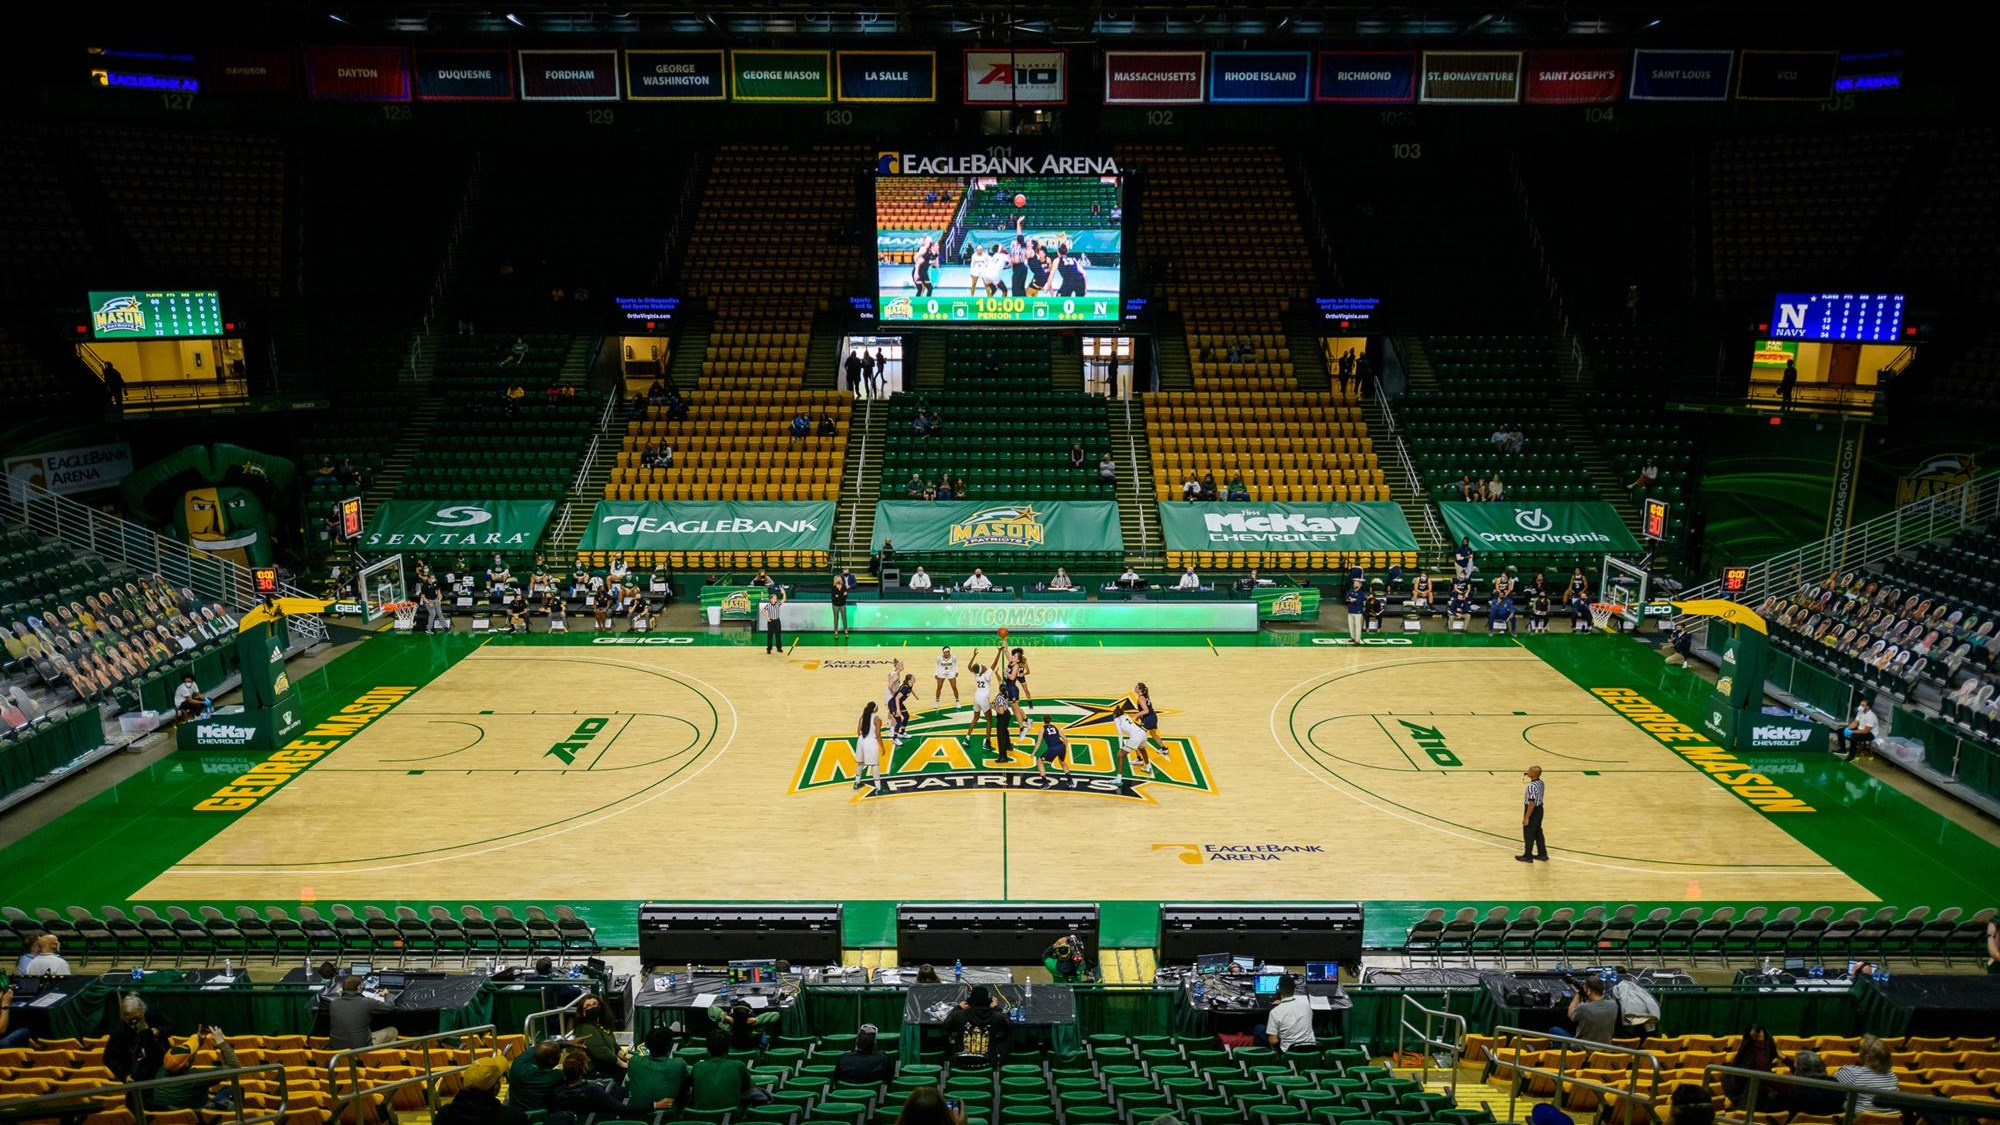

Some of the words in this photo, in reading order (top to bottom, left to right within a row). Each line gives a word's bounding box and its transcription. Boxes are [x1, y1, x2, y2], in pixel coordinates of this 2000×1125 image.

[337, 68, 379, 79] DAYTON
[438, 69, 492, 81] DUQUESNE
[545, 69, 595, 80] FORDHAM
[655, 64, 696, 74] GEORGE
[743, 70, 783, 81] GEORGE
[784, 70, 821, 81] MASON
[1651, 69, 1679, 80] SAINT
[1681, 69, 1712, 80] LOUIS
[1776, 70, 1798, 81] VCU
[642, 75, 710, 86] WASHINGTON
[865, 71, 878, 82] LA
[880, 71, 909, 82] SALLE
[1114, 71, 1197, 82] MASSACHUSETTS
[1224, 71, 1260, 82] RHODE
[1261, 71, 1297, 82] ISLAND
[1337, 71, 1392, 81] RICHMOND
[1427, 72, 1441, 82] ST.
[1443, 72, 1514, 82] BONAVENTURE
[1539, 71, 1567, 81] SAINT
[1568, 70, 1616, 82] JOSEPH'S
[161, 93, 195, 110] 127
[383, 104, 413, 121] 128
[587, 109, 614, 125] 129
[825, 110, 852, 125] 130
[1147, 110, 1173, 126] 102
[1584, 106, 1616, 123] 104
[1392, 143, 1423, 159] 103
[903, 154, 1037, 174] EAGLEBANK
[1040, 154, 1119, 174] ARENA
[927, 299, 939, 314] 0
[975, 298, 1025, 313] 10:00
[1063, 299, 1075, 314] 0
[1093, 301, 1108, 314] N
[96, 312, 144, 327] MASON
[1778, 304, 1808, 329] N
[47, 447, 129, 471] EAGLEBANK
[52, 468, 101, 486] ARENA
[636, 517, 819, 534] EAGLEBANK
[1203, 513, 1361, 535] McKay
[366, 532, 525, 545] SENTARA
[953, 523, 1042, 542] MASON
[1208, 533, 1339, 542] CHEVROLET
[1480, 531, 1610, 544] OrthoVirginia
[969, 537, 1024, 545] PATRIOTS
[256, 570, 274, 579] 10:00
[1727, 570, 1745, 579] 10:00
[258, 579, 272, 589] 30
[1727, 579, 1741, 589] 30
[592, 637, 694, 645] GEICO
[976, 681, 986, 689] 22
[197, 725, 257, 740] McKay
[1046, 727, 1057, 735] 13
[1752, 727, 1812, 742] McKay
[193, 740, 341, 811] GEORGE
[304, 686, 418, 736] MASON
[1589, 687, 1711, 742] GEORGE
[1672, 746, 1818, 812] MASON
[808, 736, 1199, 784] MASON
[887, 774, 1122, 792] PATRIOTS
[1204, 844, 1325, 853] EAGLEBANK
[1210, 853, 1281, 861] ARENA
